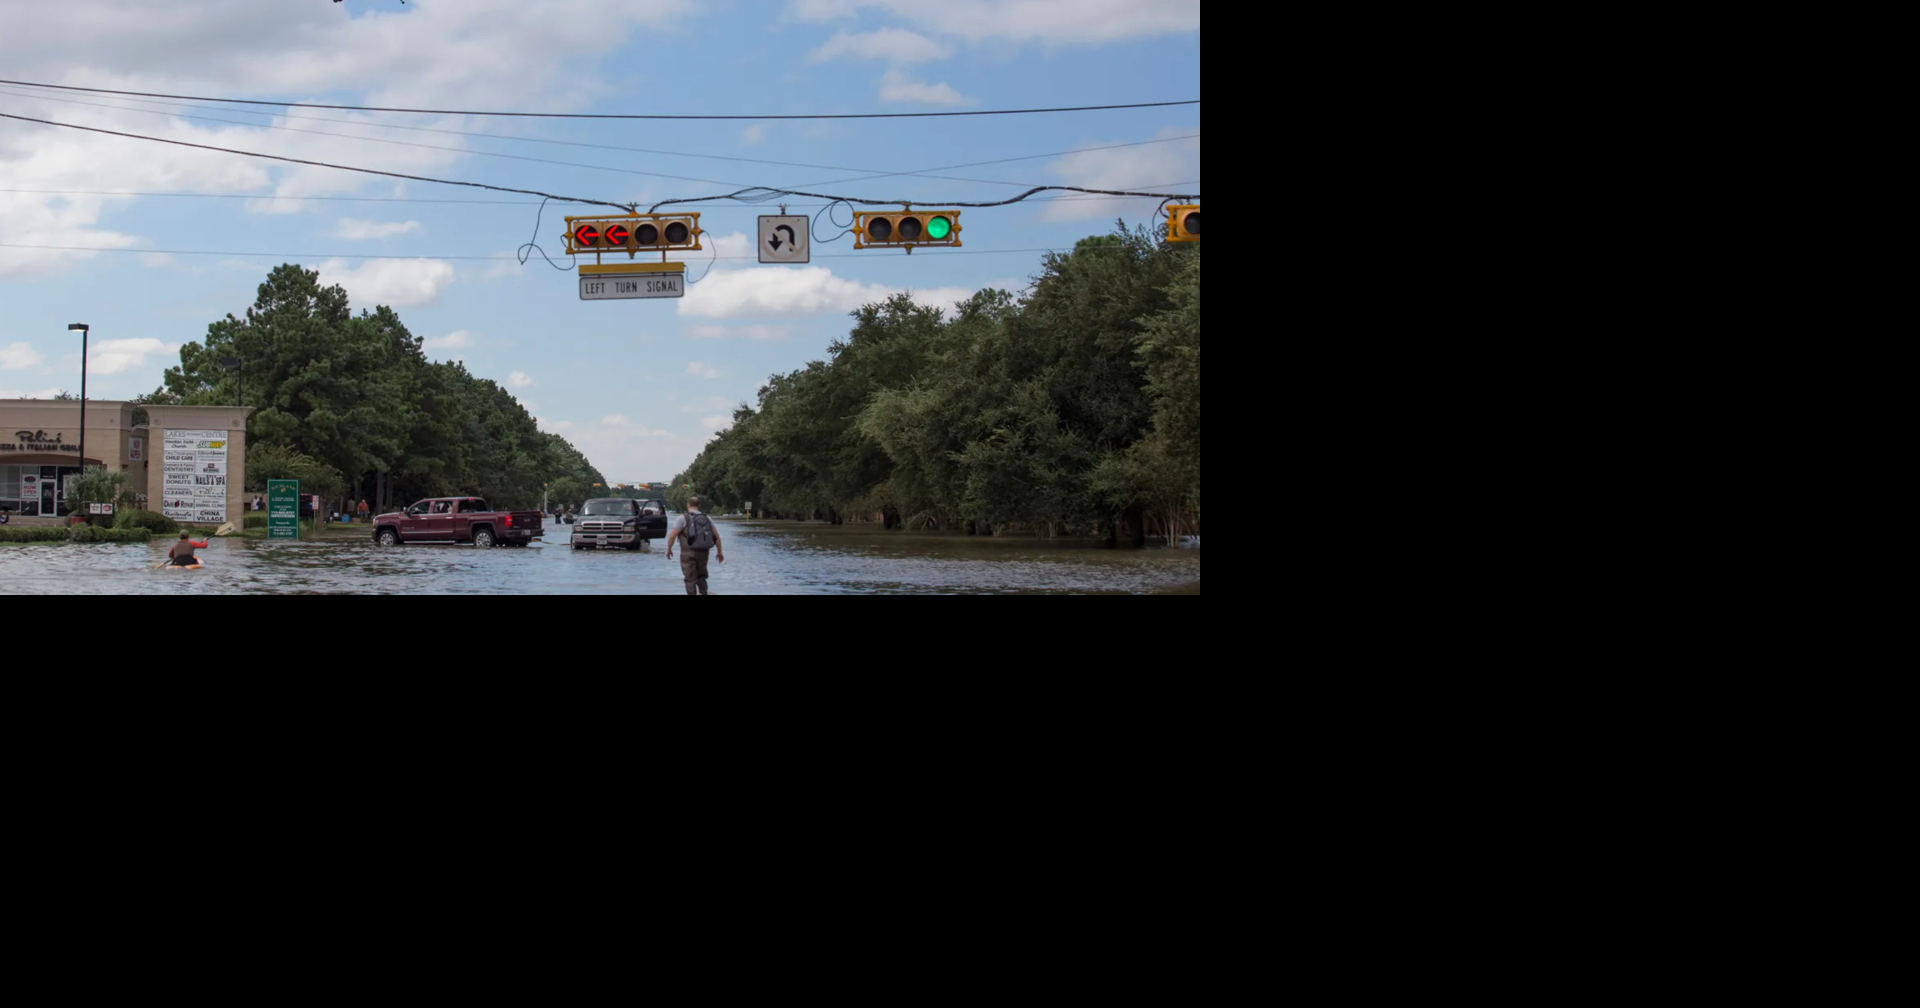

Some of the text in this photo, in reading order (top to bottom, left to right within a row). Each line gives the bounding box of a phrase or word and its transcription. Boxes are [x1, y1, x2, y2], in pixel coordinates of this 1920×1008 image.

[585, 280, 678, 294] LEFT TURN SIGNAL
[197, 440, 226, 449] SUBWAY
[196, 476, 210, 485] NAILS
[216, 476, 225, 486] SPA
